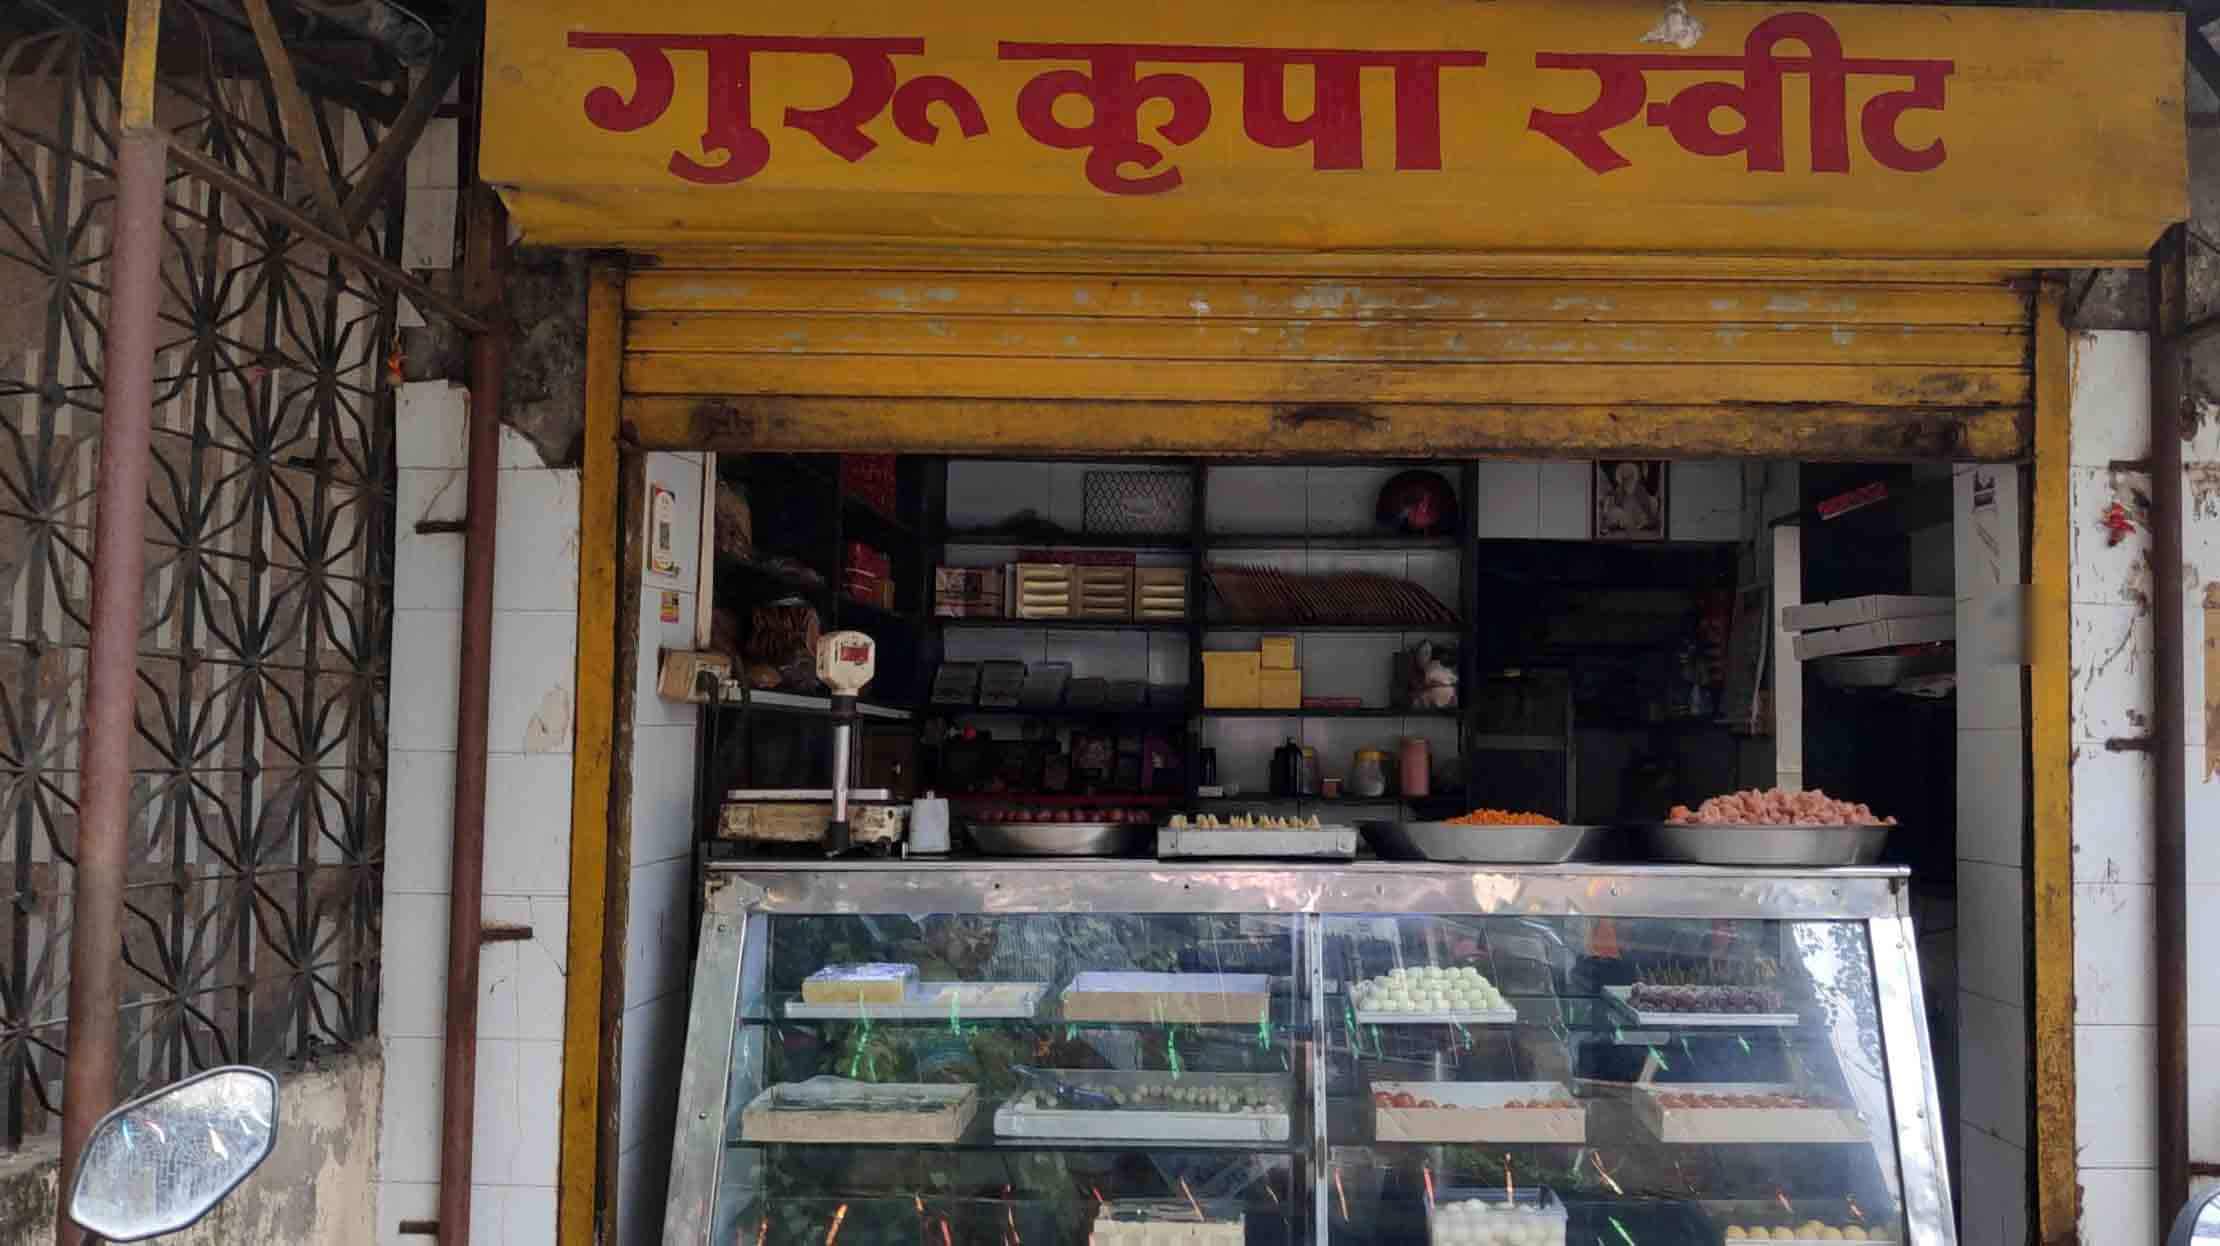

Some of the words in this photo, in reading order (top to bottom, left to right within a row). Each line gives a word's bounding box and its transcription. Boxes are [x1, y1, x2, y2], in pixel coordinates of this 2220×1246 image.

[569, 31, 989, 185] गुरू
[997, 40, 1487, 196] कृपा
[1527, 11, 1955, 175] स्वीट
